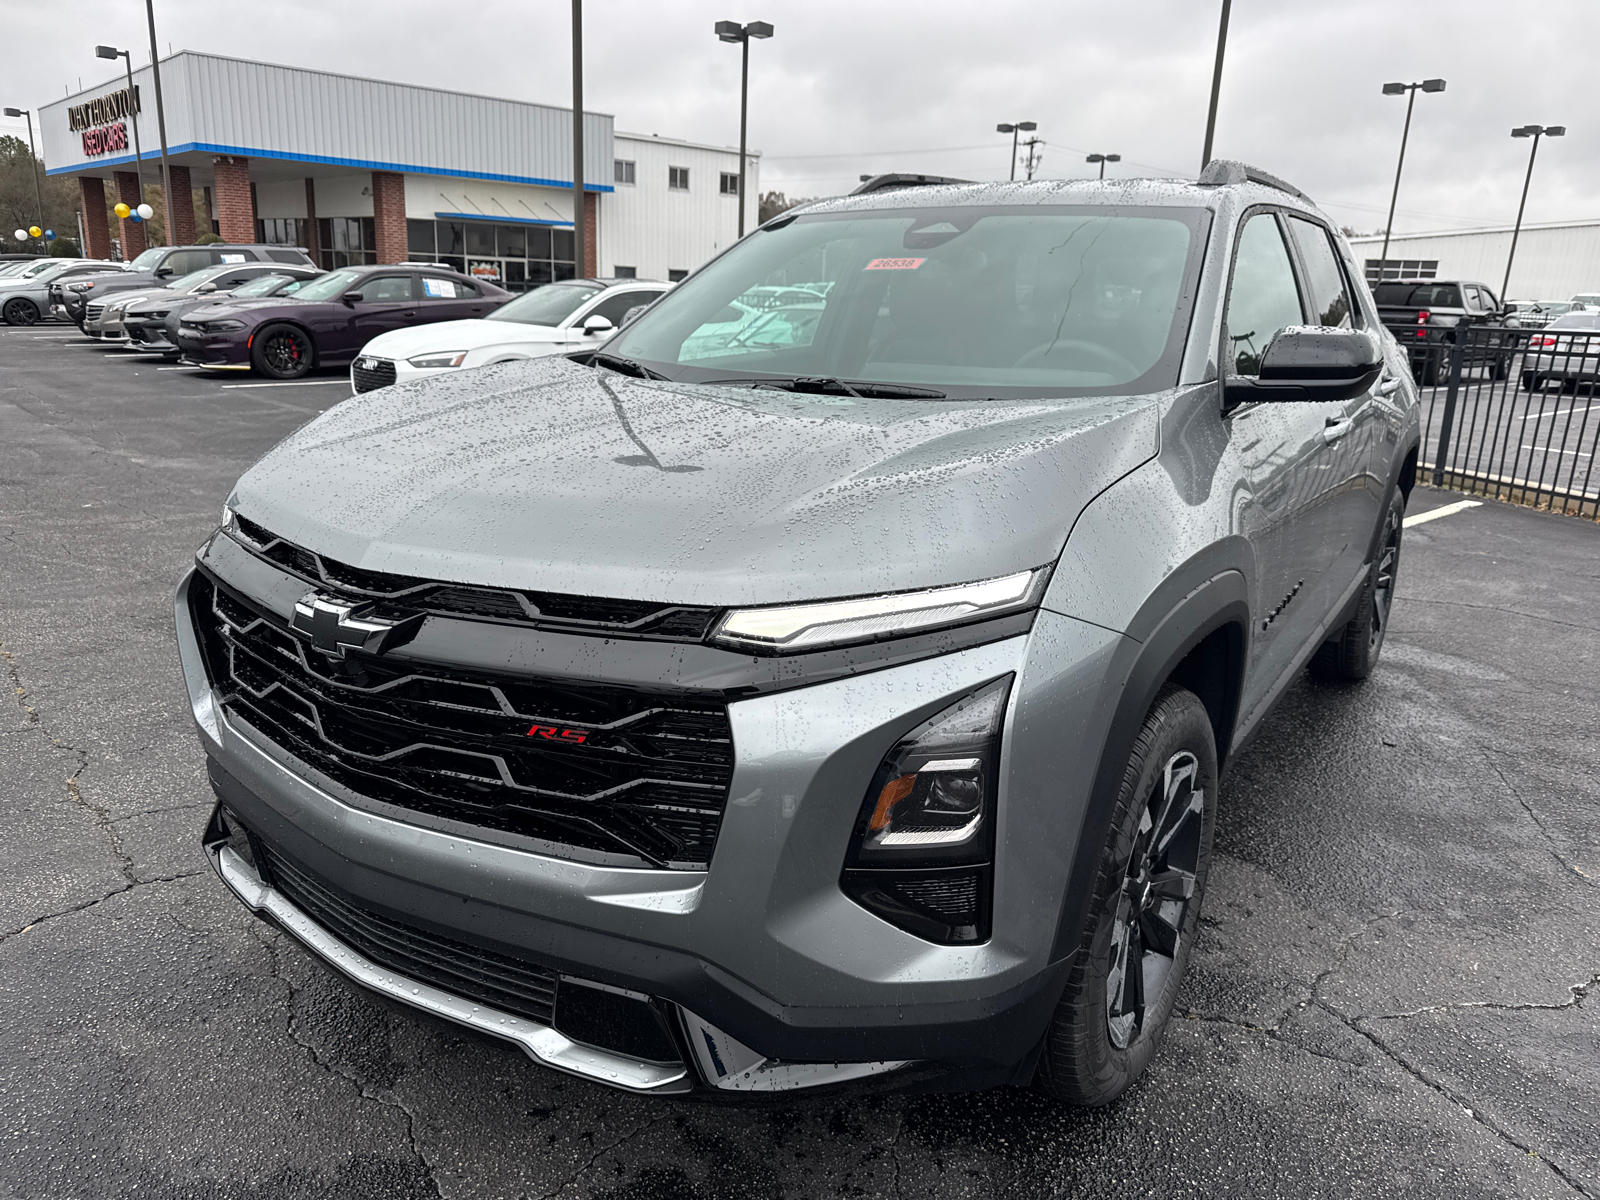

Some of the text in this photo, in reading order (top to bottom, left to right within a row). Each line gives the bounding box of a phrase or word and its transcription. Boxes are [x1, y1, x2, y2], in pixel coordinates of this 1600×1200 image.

[67, 85, 141, 132] JOHN THORNTON
[81, 121, 129, 156] USED CARS
[526, 724, 590, 744] RS
